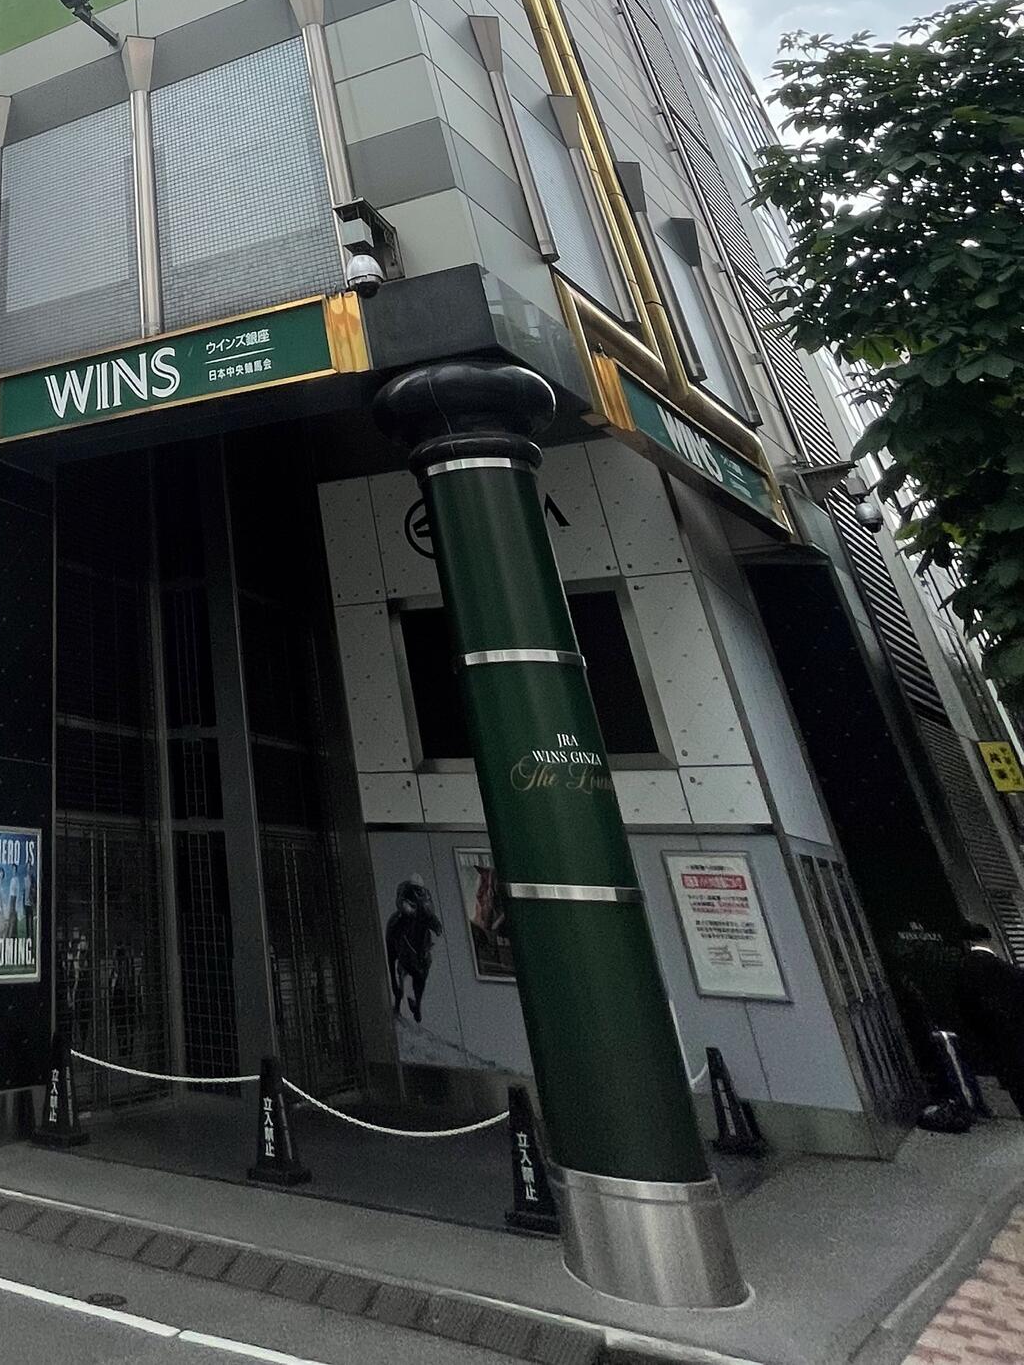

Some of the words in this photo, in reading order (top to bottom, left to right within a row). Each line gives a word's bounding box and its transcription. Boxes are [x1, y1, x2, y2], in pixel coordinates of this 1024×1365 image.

[44, 346, 181, 419] WINS
[656, 403, 724, 483] WINS
[532, 750, 568, 764] WINS
[570, 751, 603, 766] GINZA
[556, 733, 579, 748] JRA
[25, 840, 35, 866] IS
[262, 1096, 276, 1157] 立入禁止
[516, 1130, 539, 1202] 立入禁止
